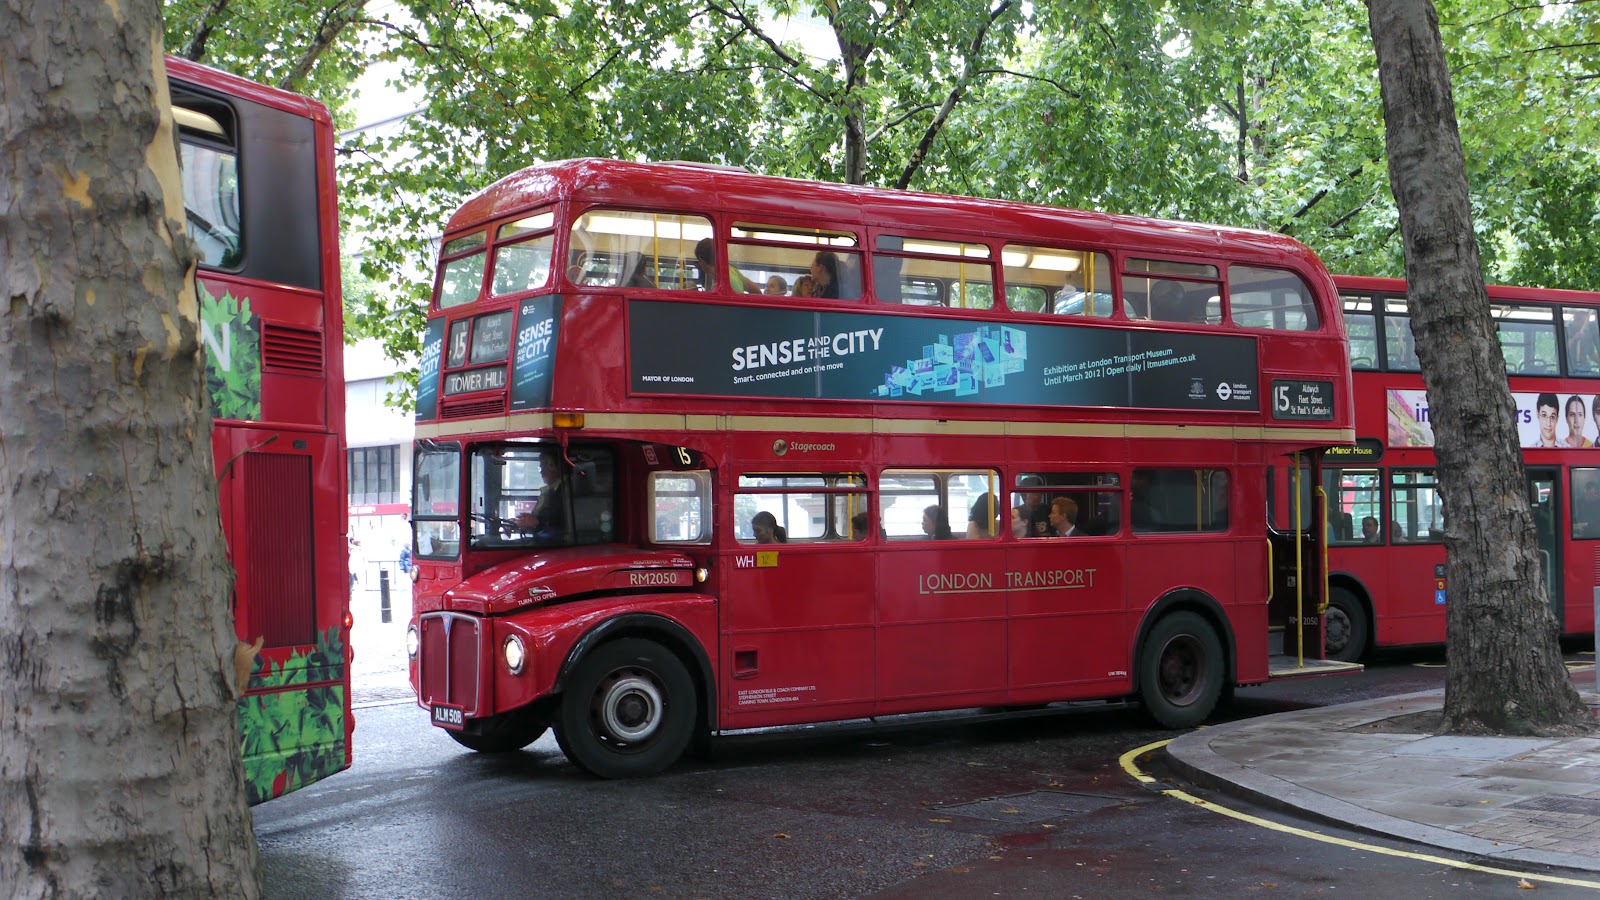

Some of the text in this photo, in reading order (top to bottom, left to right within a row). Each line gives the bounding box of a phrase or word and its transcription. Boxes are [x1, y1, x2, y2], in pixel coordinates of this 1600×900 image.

[518, 318, 553, 346] SENSE
[453, 332, 467, 360] 15
[526, 336, 551, 359] CITY
[732, 328, 884, 370] SENSE AND THE CITY
[424, 355, 440, 375] CITY
[1044, 364, 1077, 376] Exhibition
[1088, 358, 1112, 368] London
[1114, 353, 1145, 363] Transport
[1146, 349, 1172, 358] Museum
[1044, 353, 1196, 386] Until March 2012 Open daily ltmuseum.co.uk
[451, 374, 481, 392] TOWER
[485, 371, 504, 387] HILL
[756, 369, 789, 380] connected
[1274, 386, 1289, 411] 15
[1302, 384, 1319, 395] Aldwych
[1298, 395, 1323, 404] Fleet Street
[677, 447, 691, 464] 15
[790, 441, 835, 452] Stagecoach
[1354, 446, 1372, 454] House
[736, 555, 754, 568] WH
[630, 573, 677, 585] RM2050
[919, 569, 1096, 594] LONDON TRANSPORT
[1303, 617, 1318, 625] 2050
[435, 707, 462, 723] ALM 50B
